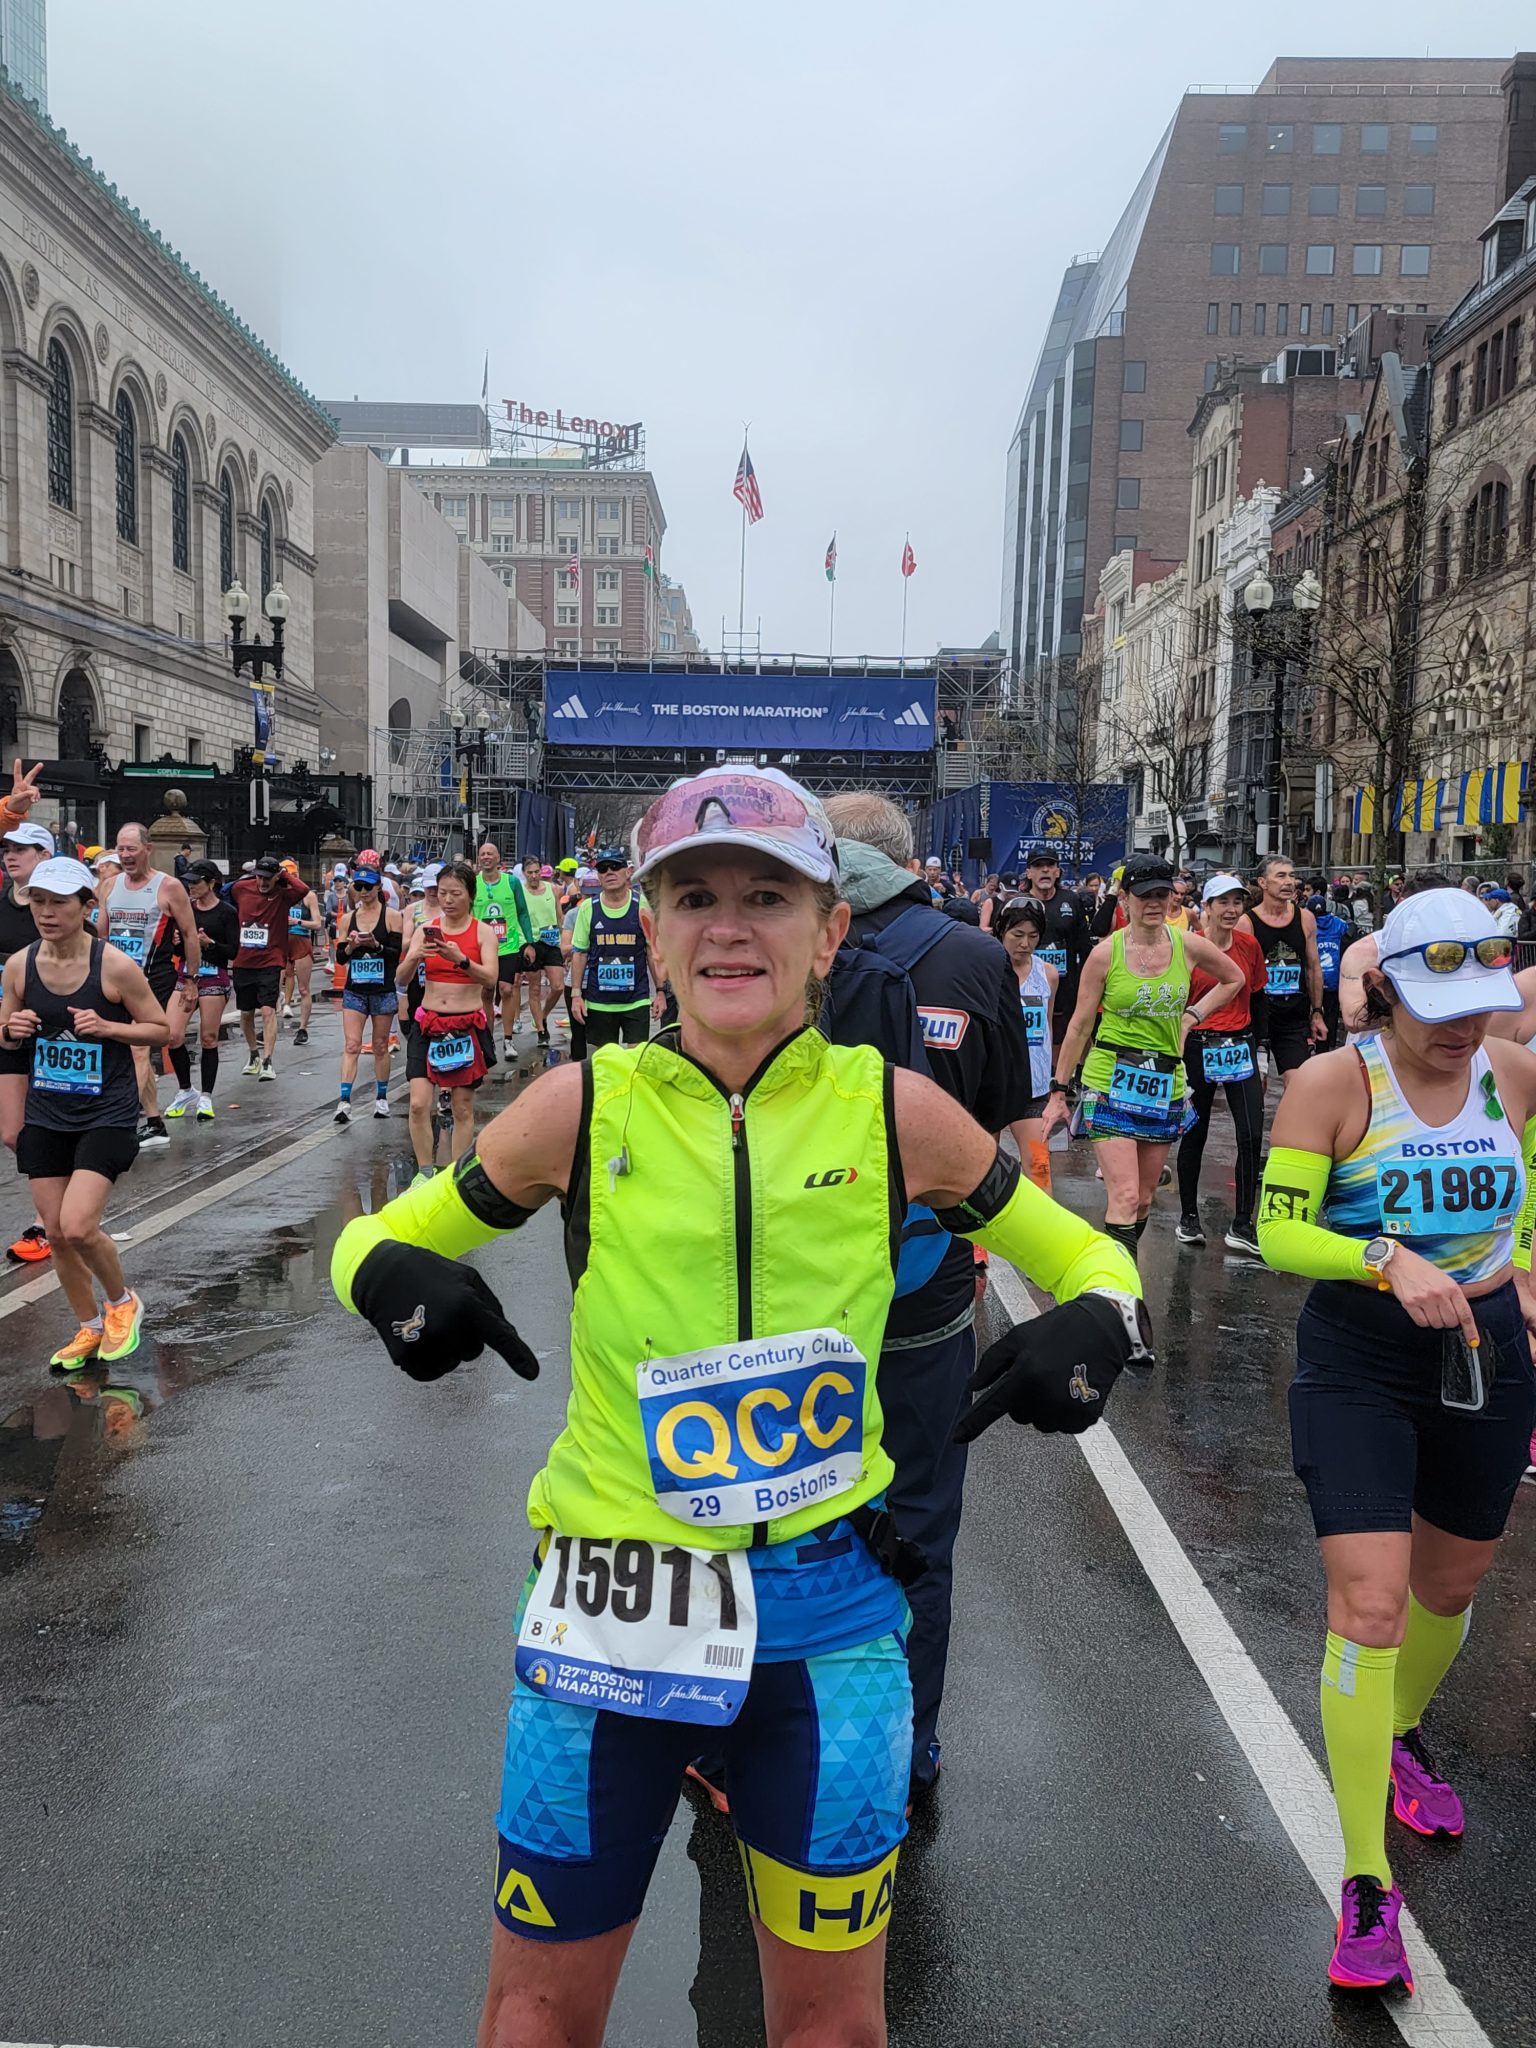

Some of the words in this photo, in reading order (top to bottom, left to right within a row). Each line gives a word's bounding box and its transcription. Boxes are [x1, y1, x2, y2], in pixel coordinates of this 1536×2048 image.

[22, 215, 70, 277] PEOPLE
[84, 275, 100, 301] AS
[113, 297, 134, 332] THE
[502, 399, 549, 427] The
[556, 409, 628, 439] Lenox
[652, 704, 679, 715] THE
[682, 704, 739, 717] BOSTON
[37, 1044, 98, 1072] 19631
[1204, 1048, 1249, 1068] 21424
[1112, 1069, 1168, 1098] 21561
[1402, 1137, 1496, 1158] BOSTON
[1381, 1164, 1517, 1215] 21987
[1390, 1223, 1398, 1231] 6
[651, 1360, 722, 1386] Quarter
[728, 1345, 805, 1371] Century
[811, 1338, 854, 1354] Club
[656, 1371, 855, 1480] QCC
[689, 1495, 721, 1518] 29
[754, 1469, 838, 1512] Bostons
[549, 1536, 738, 1631] 15911
[531, 1621, 542, 1636] 8
[558, 1663, 589, 1679] 127TH
[590, 1671, 644, 1692] BOSTON
